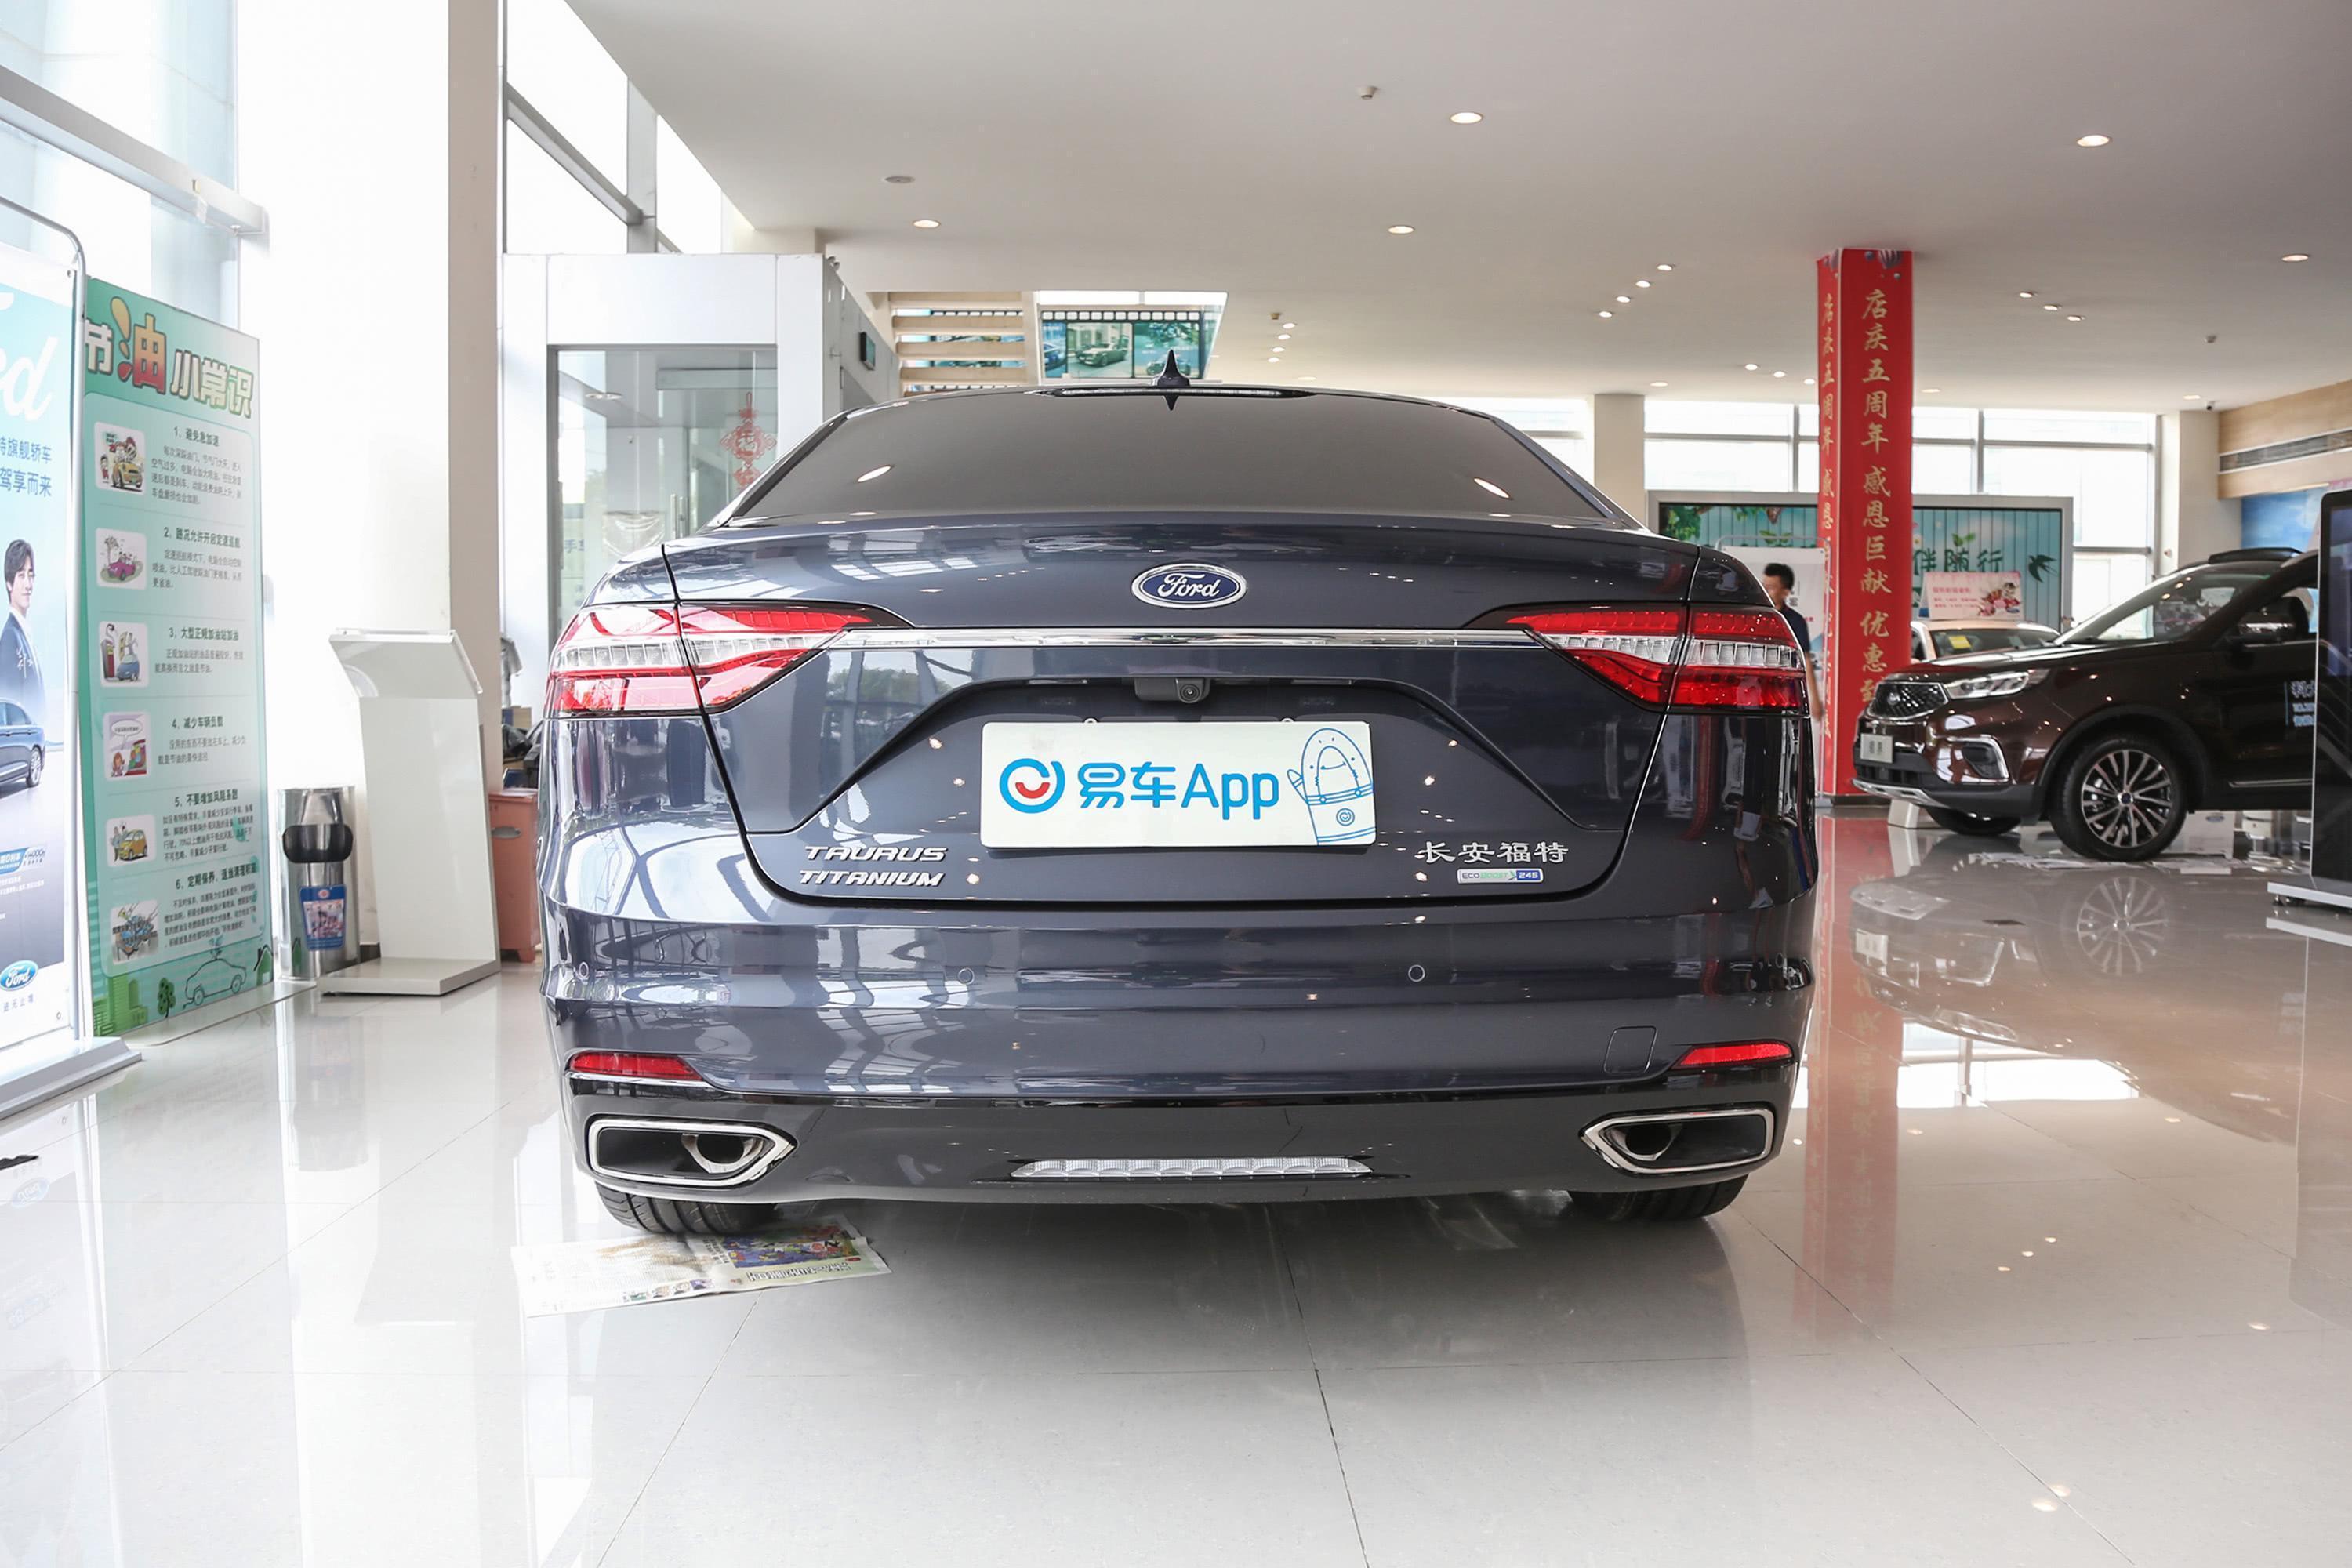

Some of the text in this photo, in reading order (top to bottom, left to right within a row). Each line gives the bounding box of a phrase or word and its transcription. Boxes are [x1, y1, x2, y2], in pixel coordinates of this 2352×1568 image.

[85, 297, 254, 419] 节油小常识
[1860, 289, 1891, 455] 店庆五周年
[1860, 466, 1891, 594] 感恩巨献
[1157, 572, 1221, 597] Ford
[1078, 761, 1279, 821] 易车App
[804, 845, 948, 862] TAURUS
[1417, 840, 1569, 863] 长安福特
[799, 869, 946, 887] TITANIUM
[1517, 870, 1538, 880] 245
